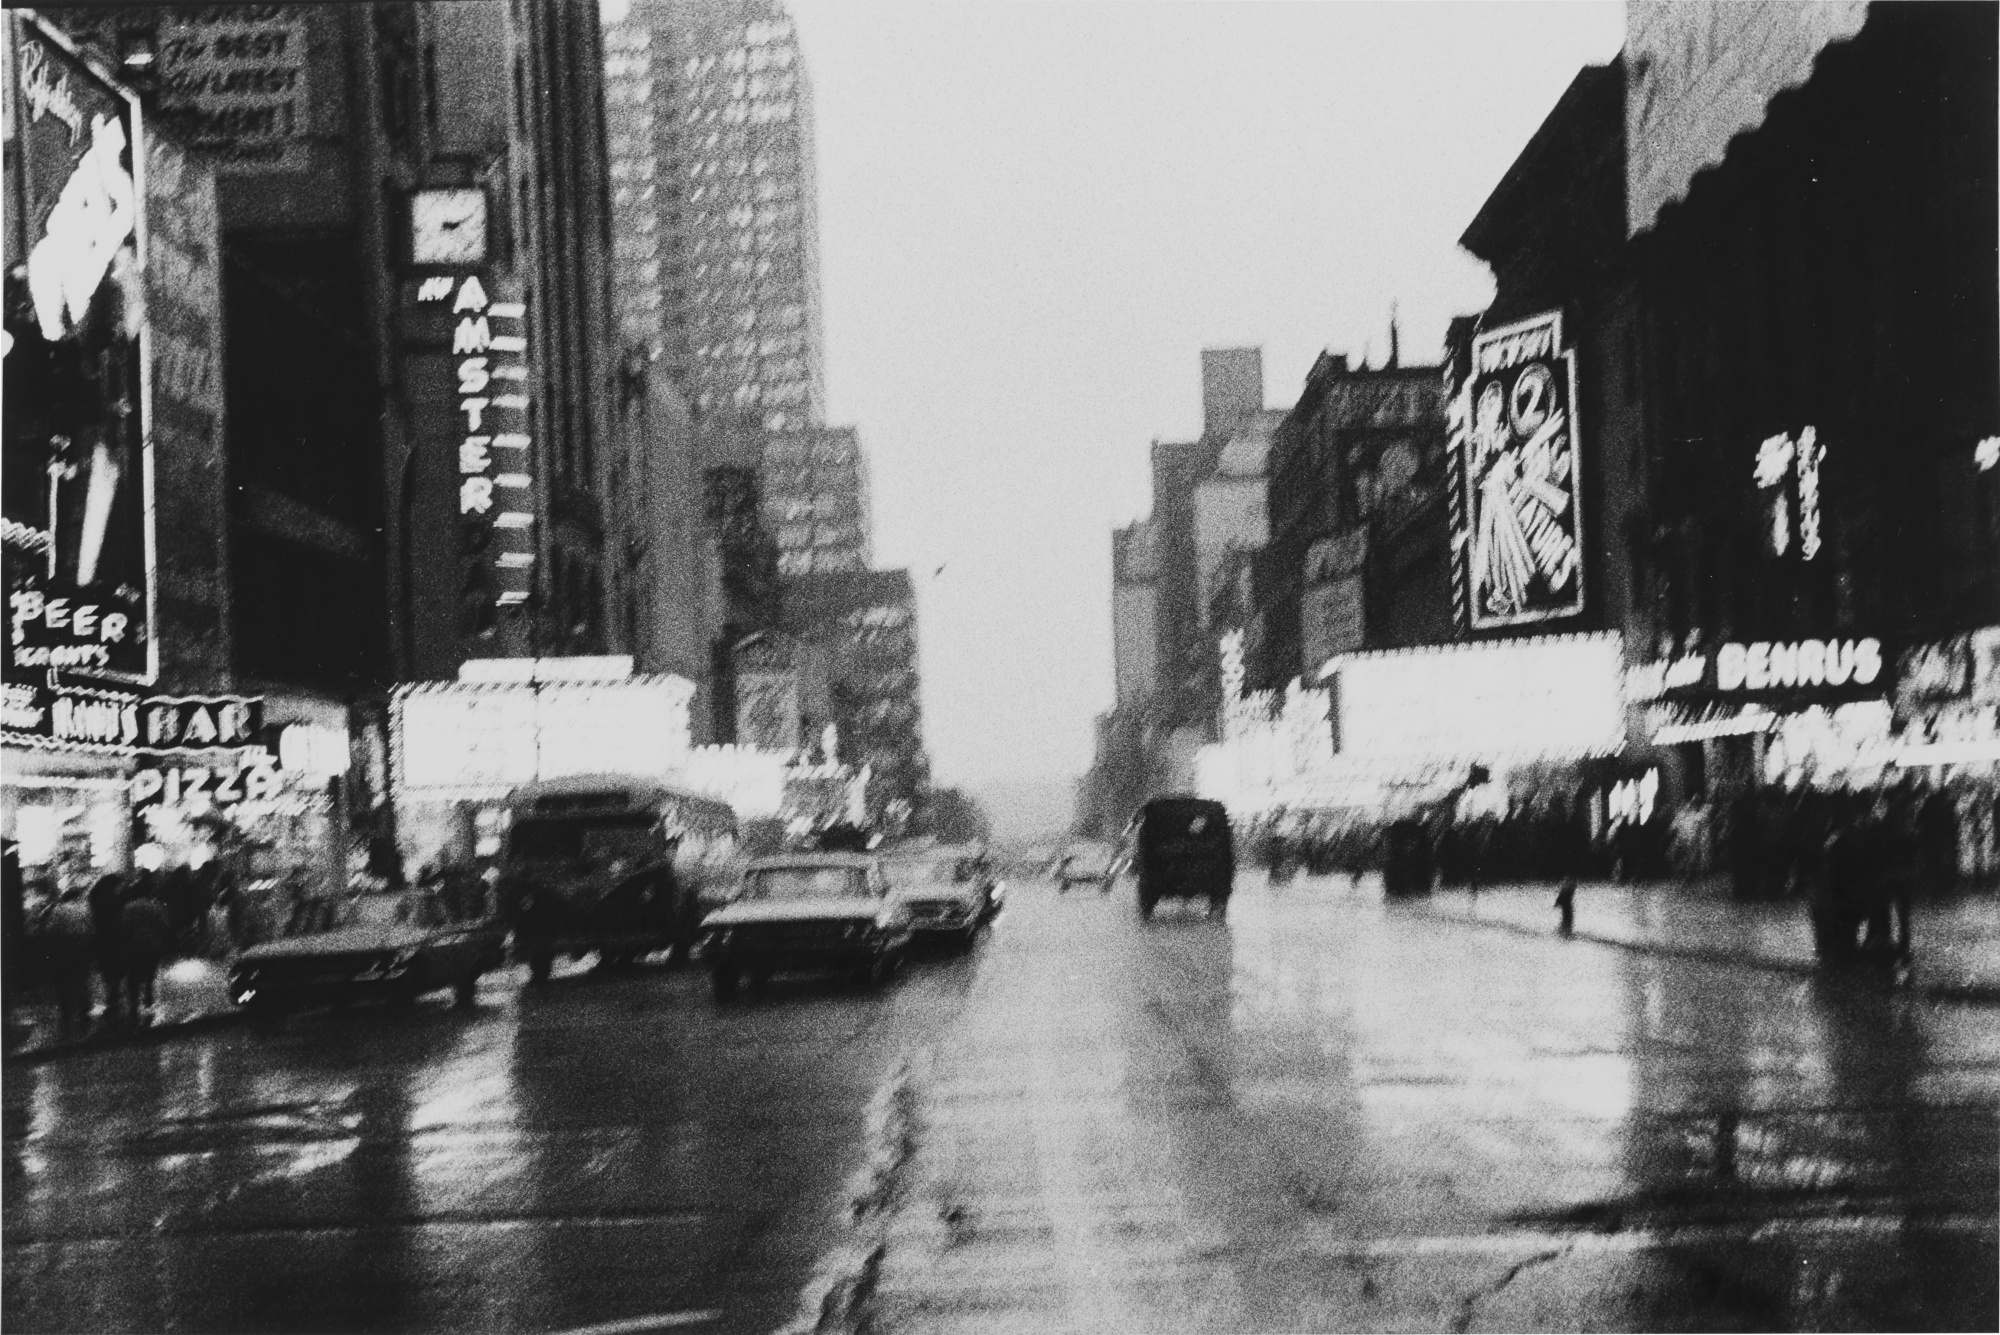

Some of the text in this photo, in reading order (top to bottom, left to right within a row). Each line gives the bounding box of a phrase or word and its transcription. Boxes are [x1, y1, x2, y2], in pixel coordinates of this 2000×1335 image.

[452, 275, 493, 515] AMSTER
[1717, 637, 1881, 690] BENRUS
[147, 703, 251, 744] BAR
[130, 766, 283, 804] PIZZA
